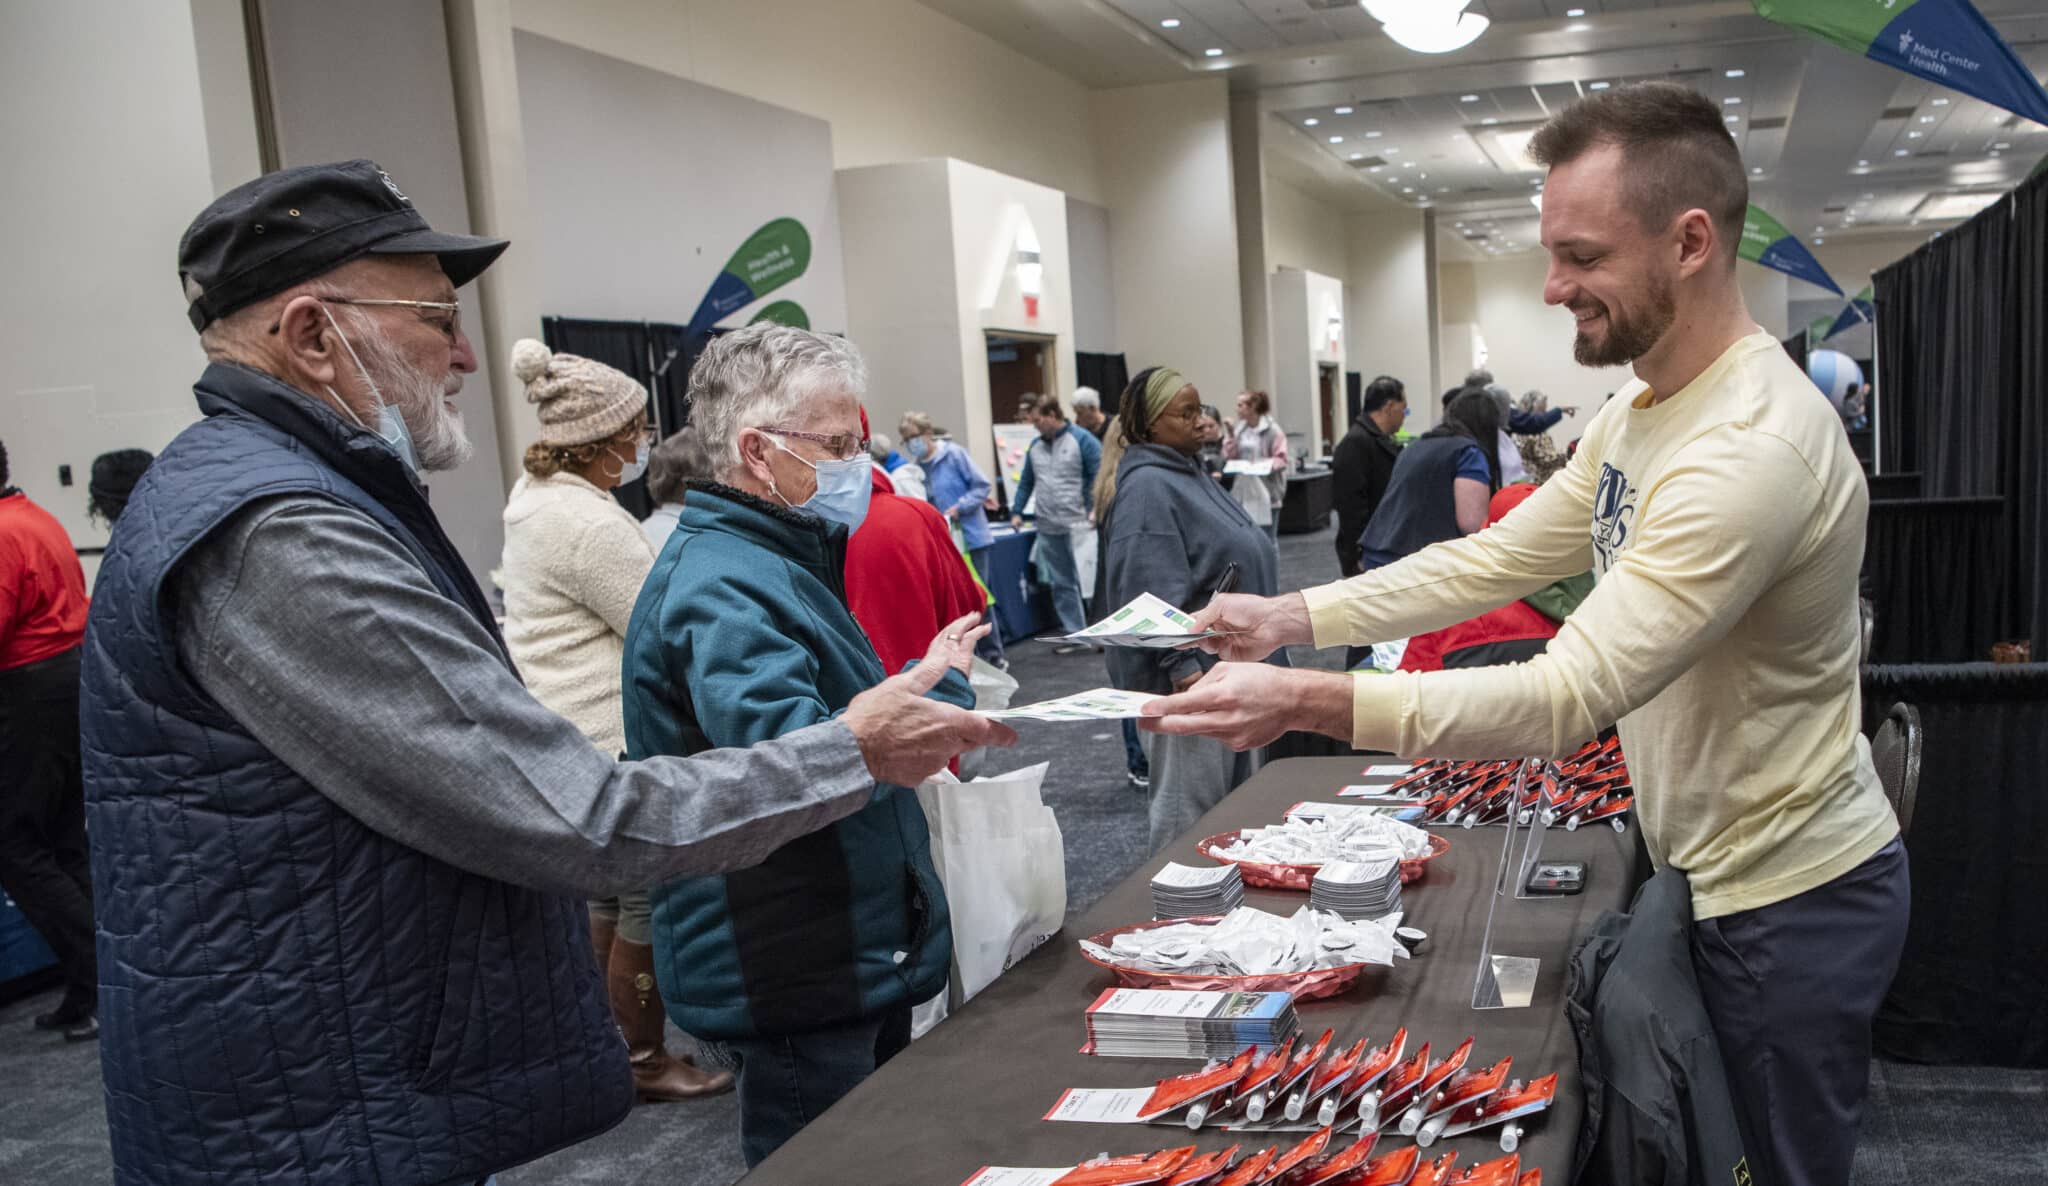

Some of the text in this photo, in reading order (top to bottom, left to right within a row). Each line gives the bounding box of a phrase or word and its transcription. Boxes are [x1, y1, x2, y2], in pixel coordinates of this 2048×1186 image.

[1909, 55, 1947, 75] Health
[1913, 43, 1980, 72] Med Center
